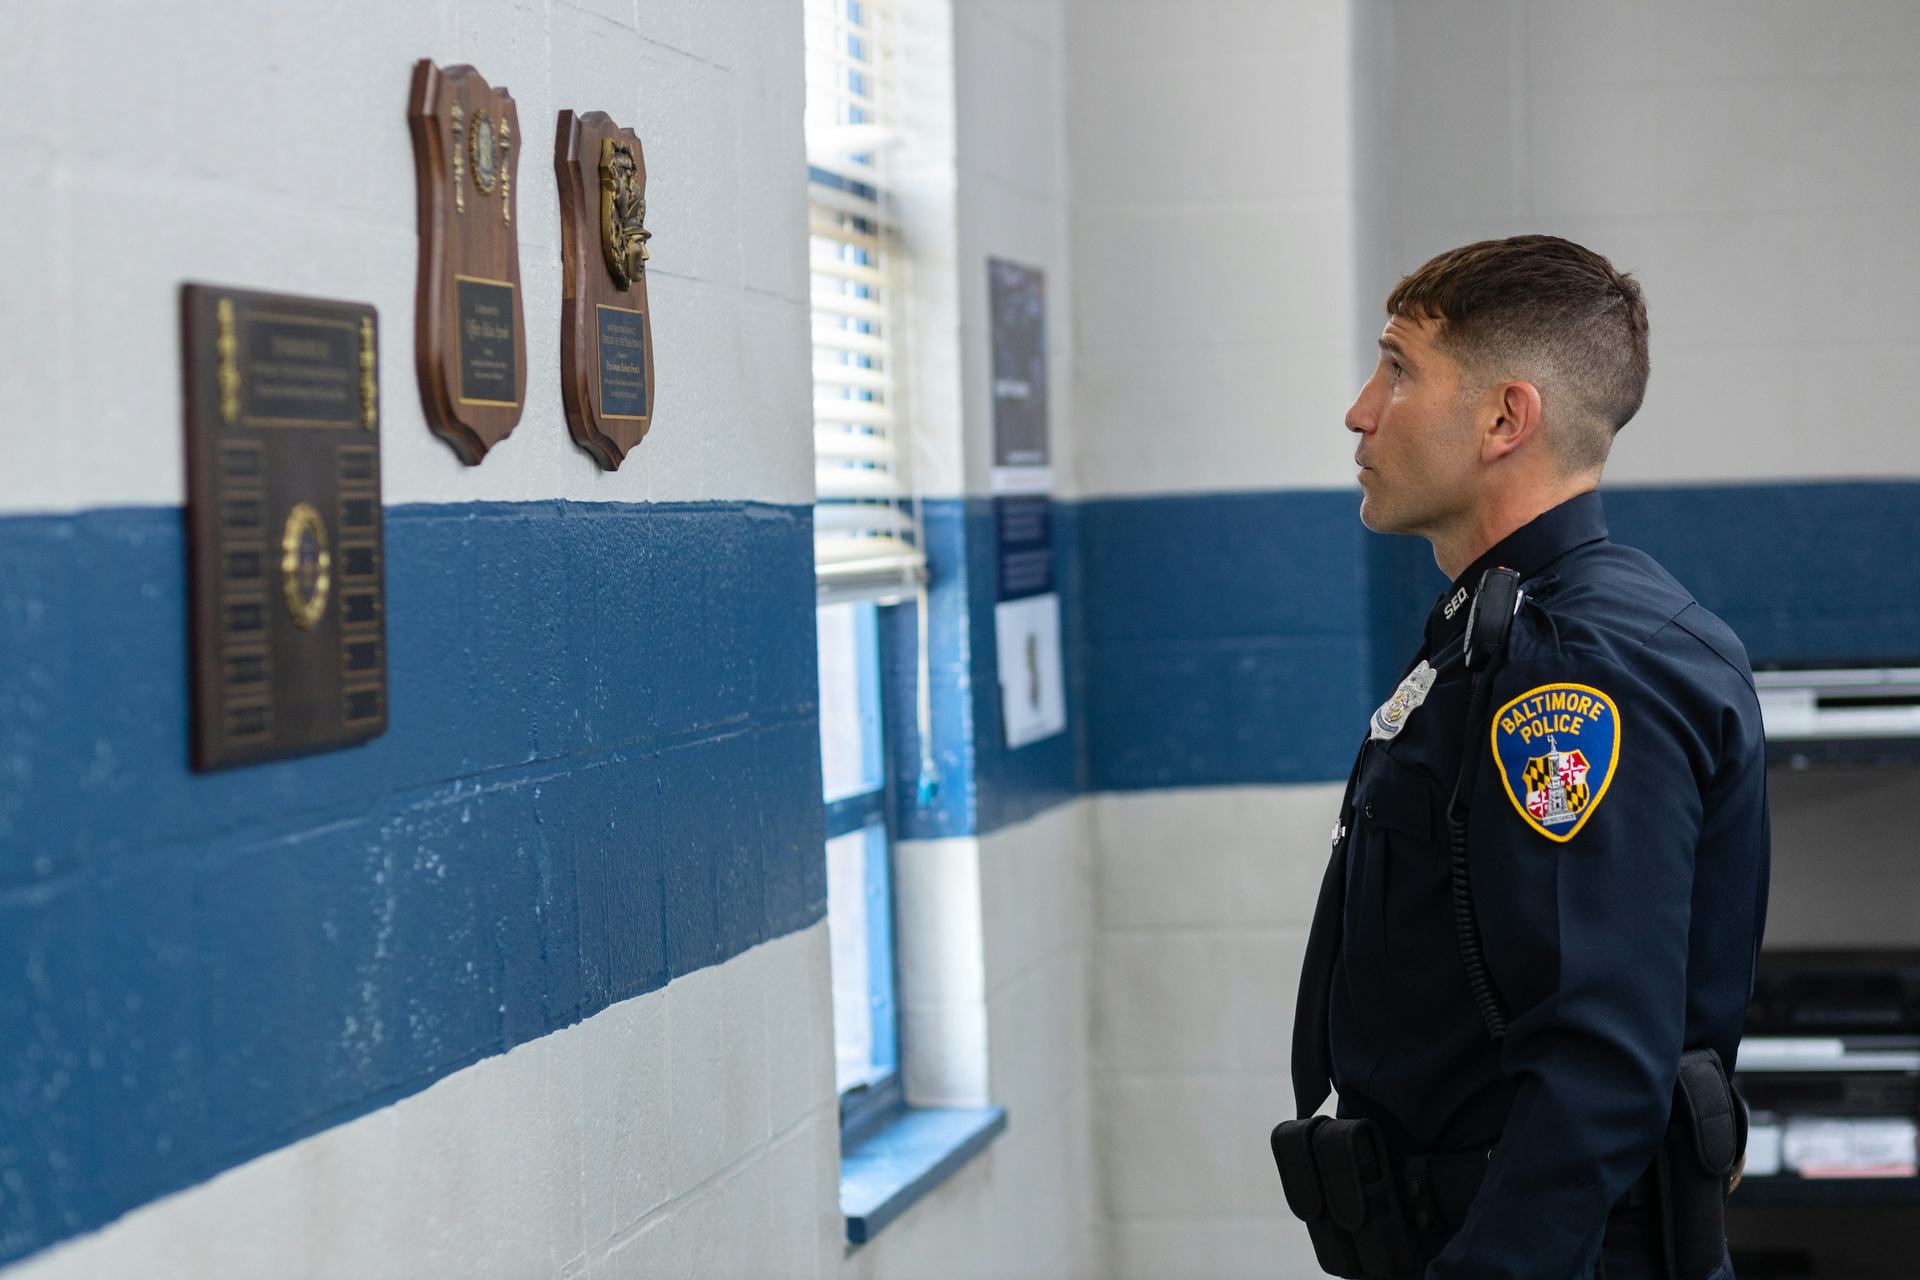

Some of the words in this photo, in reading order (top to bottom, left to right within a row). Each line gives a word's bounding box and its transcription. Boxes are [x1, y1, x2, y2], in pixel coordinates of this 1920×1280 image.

[1444, 587, 1468, 620] SED
[1501, 692, 1605, 735] BALTIMORE
[1519, 714, 1584, 744] POLICE
